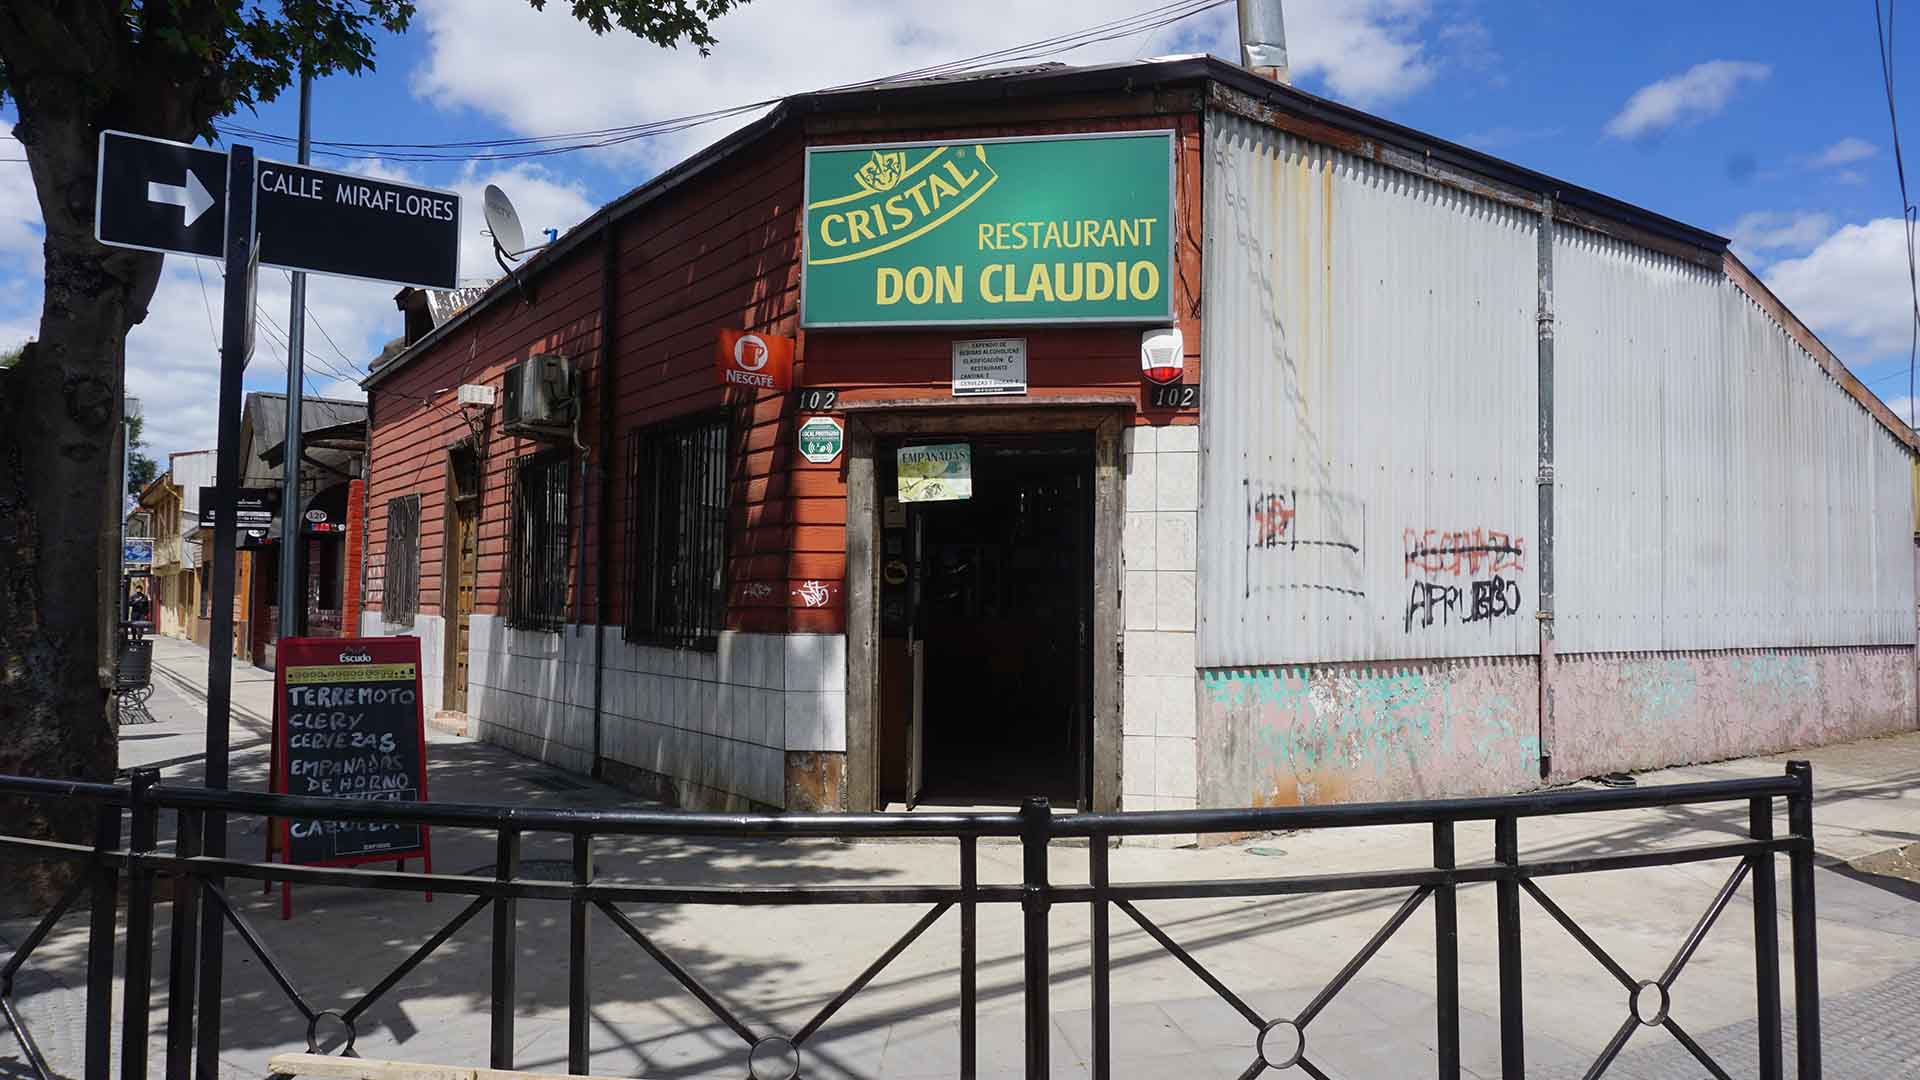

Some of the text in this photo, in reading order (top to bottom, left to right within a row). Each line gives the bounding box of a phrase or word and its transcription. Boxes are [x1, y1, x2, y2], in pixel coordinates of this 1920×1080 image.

[260, 170, 454, 221] CALLE MIRAFLORES
[819, 158, 980, 248] CRISTAL
[978, 218, 1157, 250] RESTAURANT
[876, 261, 1160, 305] DON CLAUDIO
[800, 391, 836, 409] 102
[1156, 387, 1194, 406] 102
[902, 448, 966, 464] EMPANADAS
[339, 652, 372, 663] Escudo
[287, 686, 416, 708] TERREMOTO
[288, 712, 365, 730] CLERY
[290, 732, 396, 752] CERVEZAS
[290, 754, 403, 777] EMPANADAS
[307, 773, 409, 792] DE HORNO
